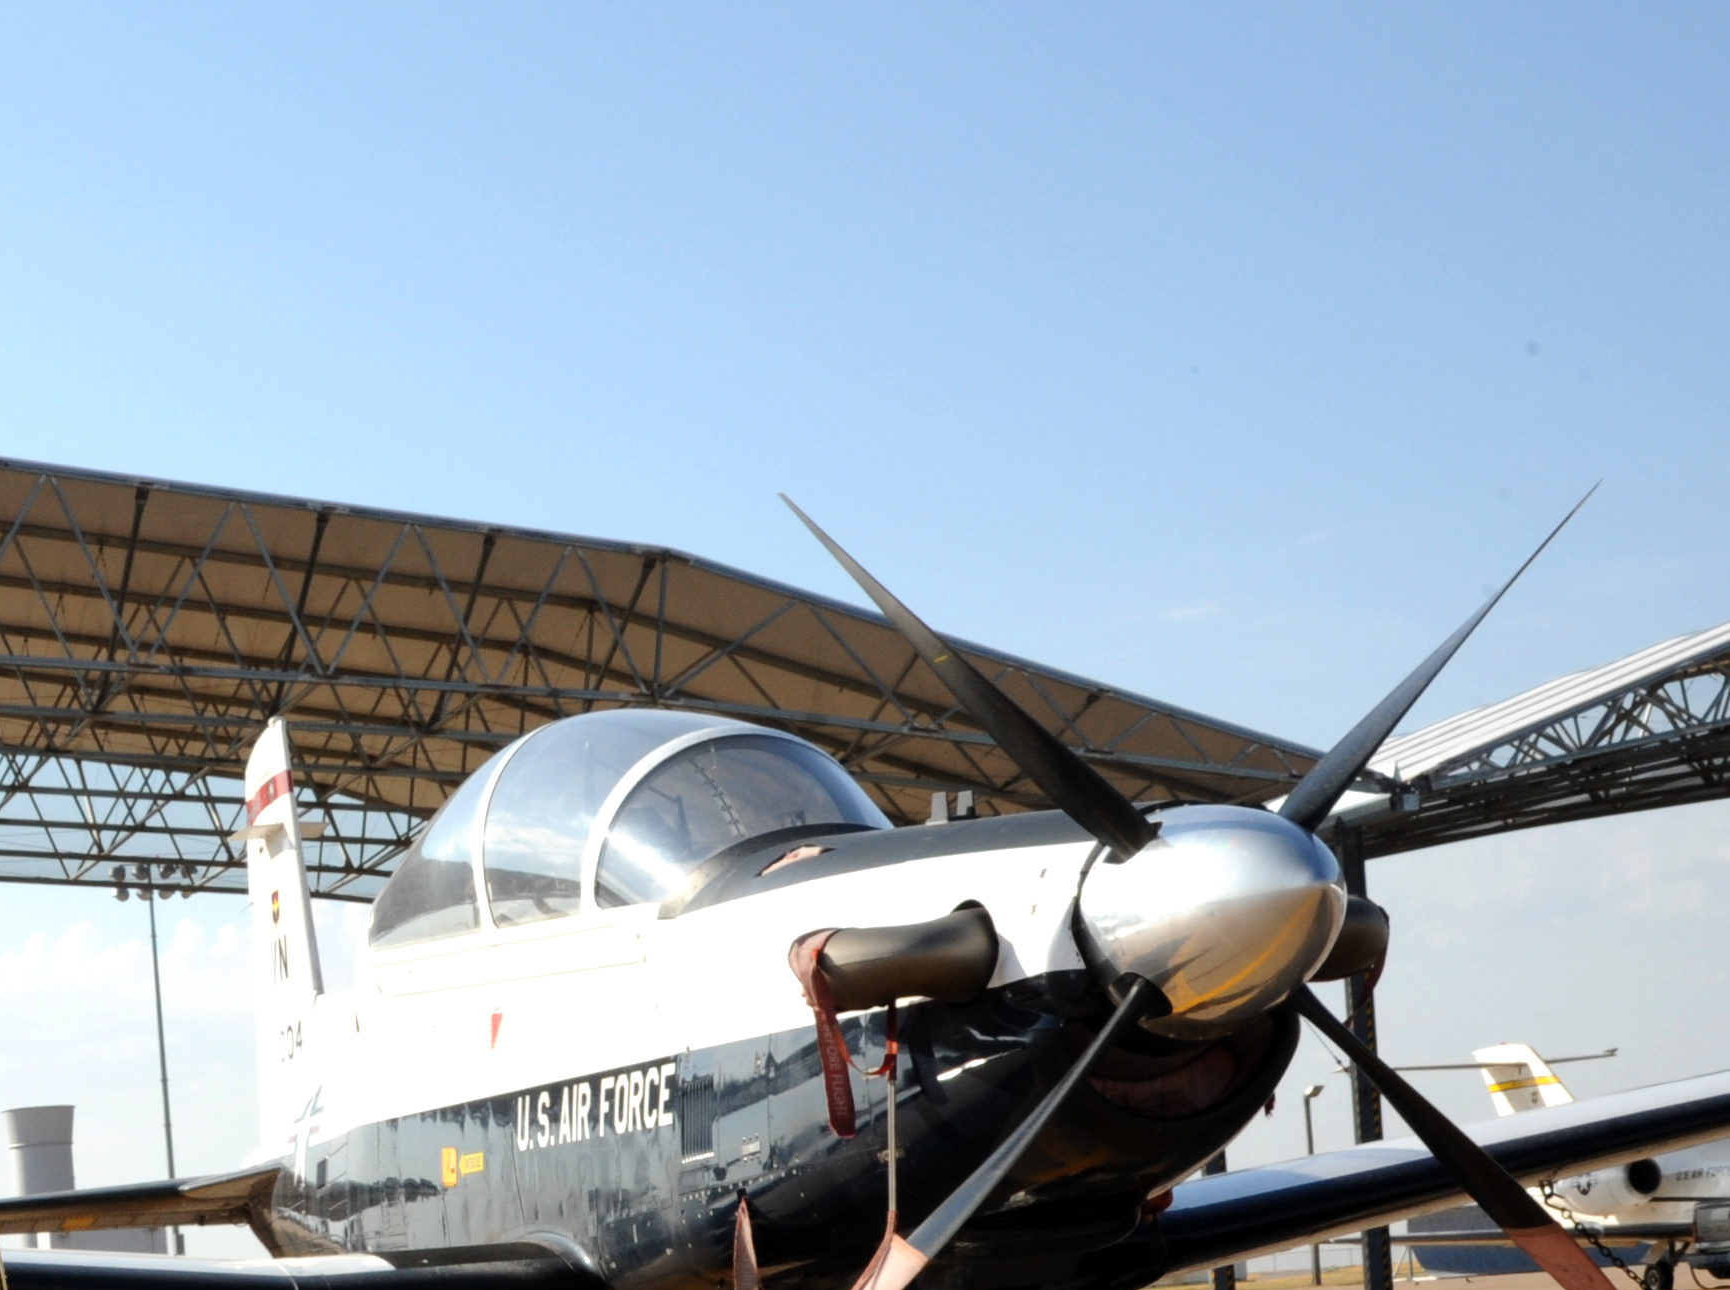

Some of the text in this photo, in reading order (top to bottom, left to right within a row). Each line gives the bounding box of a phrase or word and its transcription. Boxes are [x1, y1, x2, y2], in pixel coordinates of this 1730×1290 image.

[516, 1062, 676, 1152] U.S. AIR FORCE
[831, 1074, 849, 1118] FLIGHT
